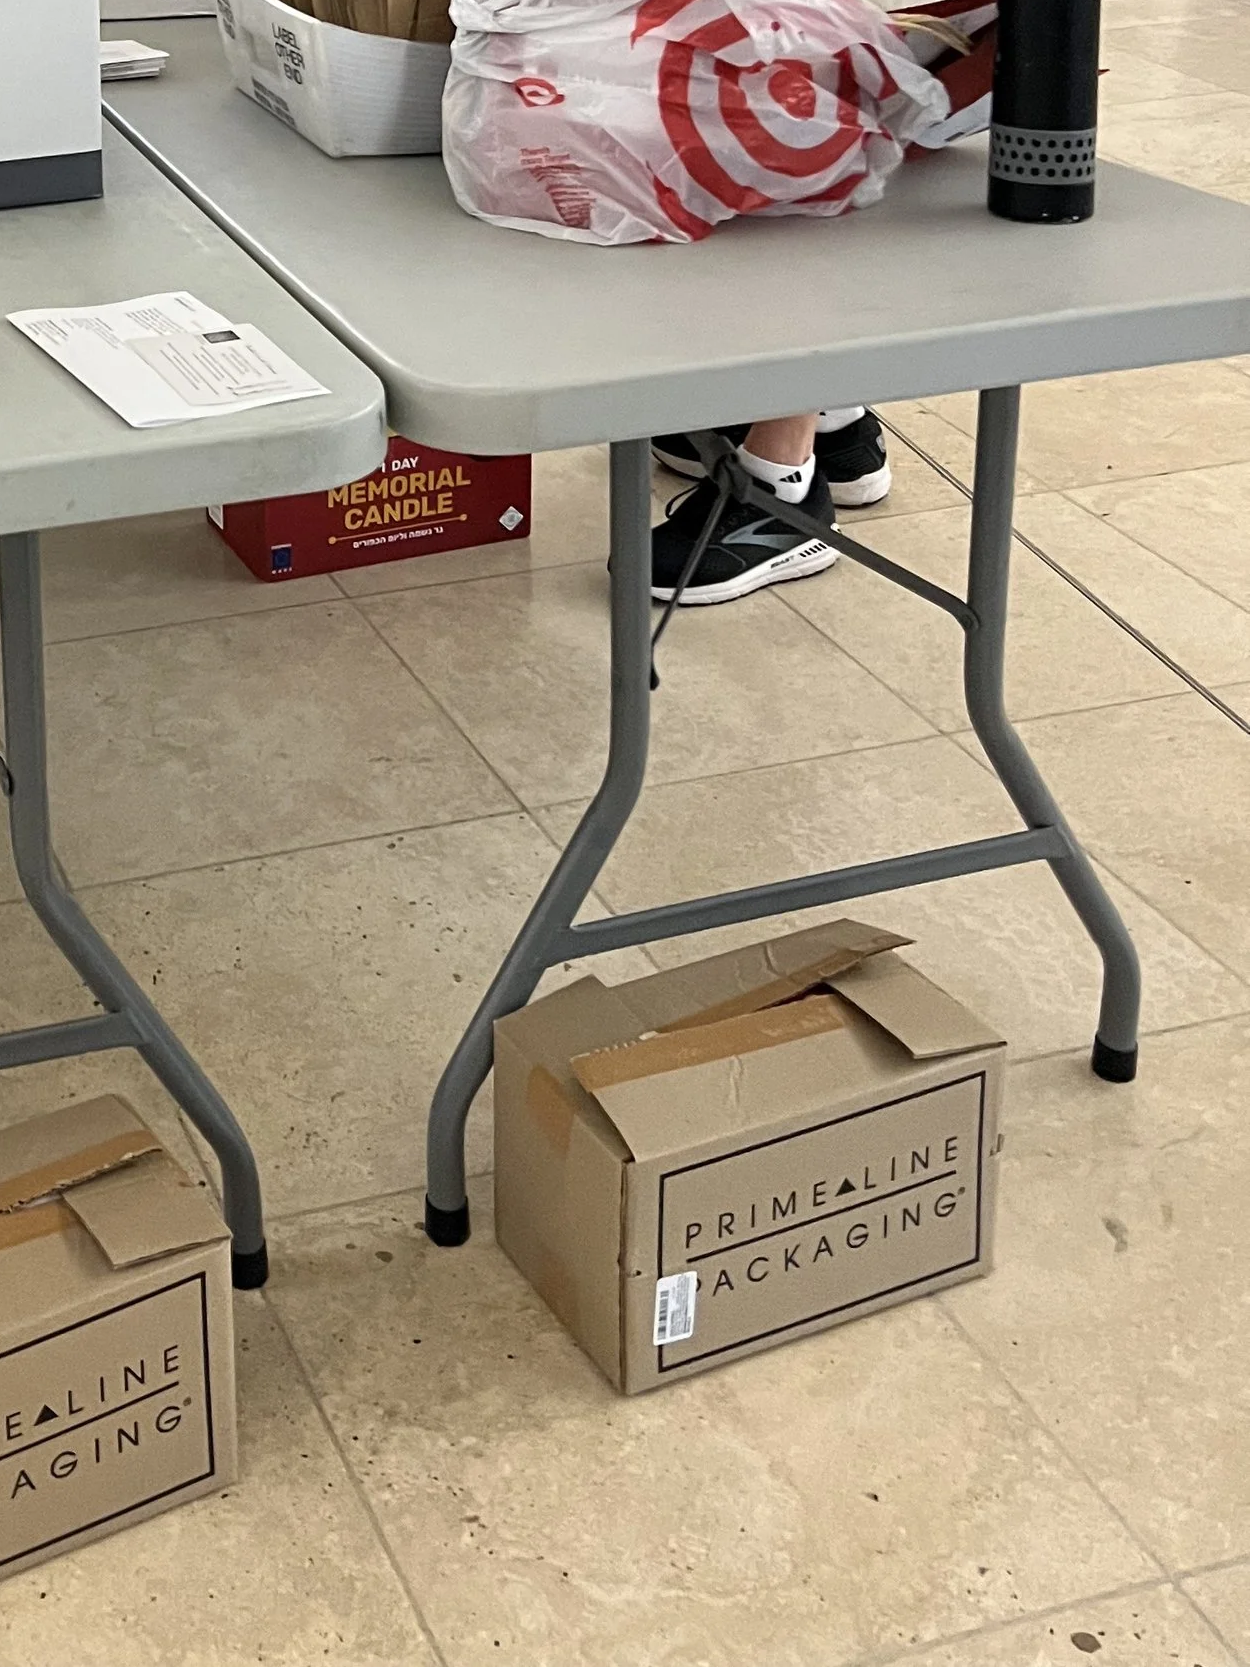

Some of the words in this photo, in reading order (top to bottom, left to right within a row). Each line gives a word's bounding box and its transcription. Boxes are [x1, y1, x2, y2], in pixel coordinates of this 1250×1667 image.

[327, 466, 471, 508] MEMORIAL
[391, 456, 419, 472] DAY
[344, 492, 453, 530] CANDLE
[685, 1180, 827, 1249] PRIME
[864, 1136, 958, 1191] LINE
[695, 1191, 959, 1297] ACKAGING
[68, 1344, 180, 1415] LINE
